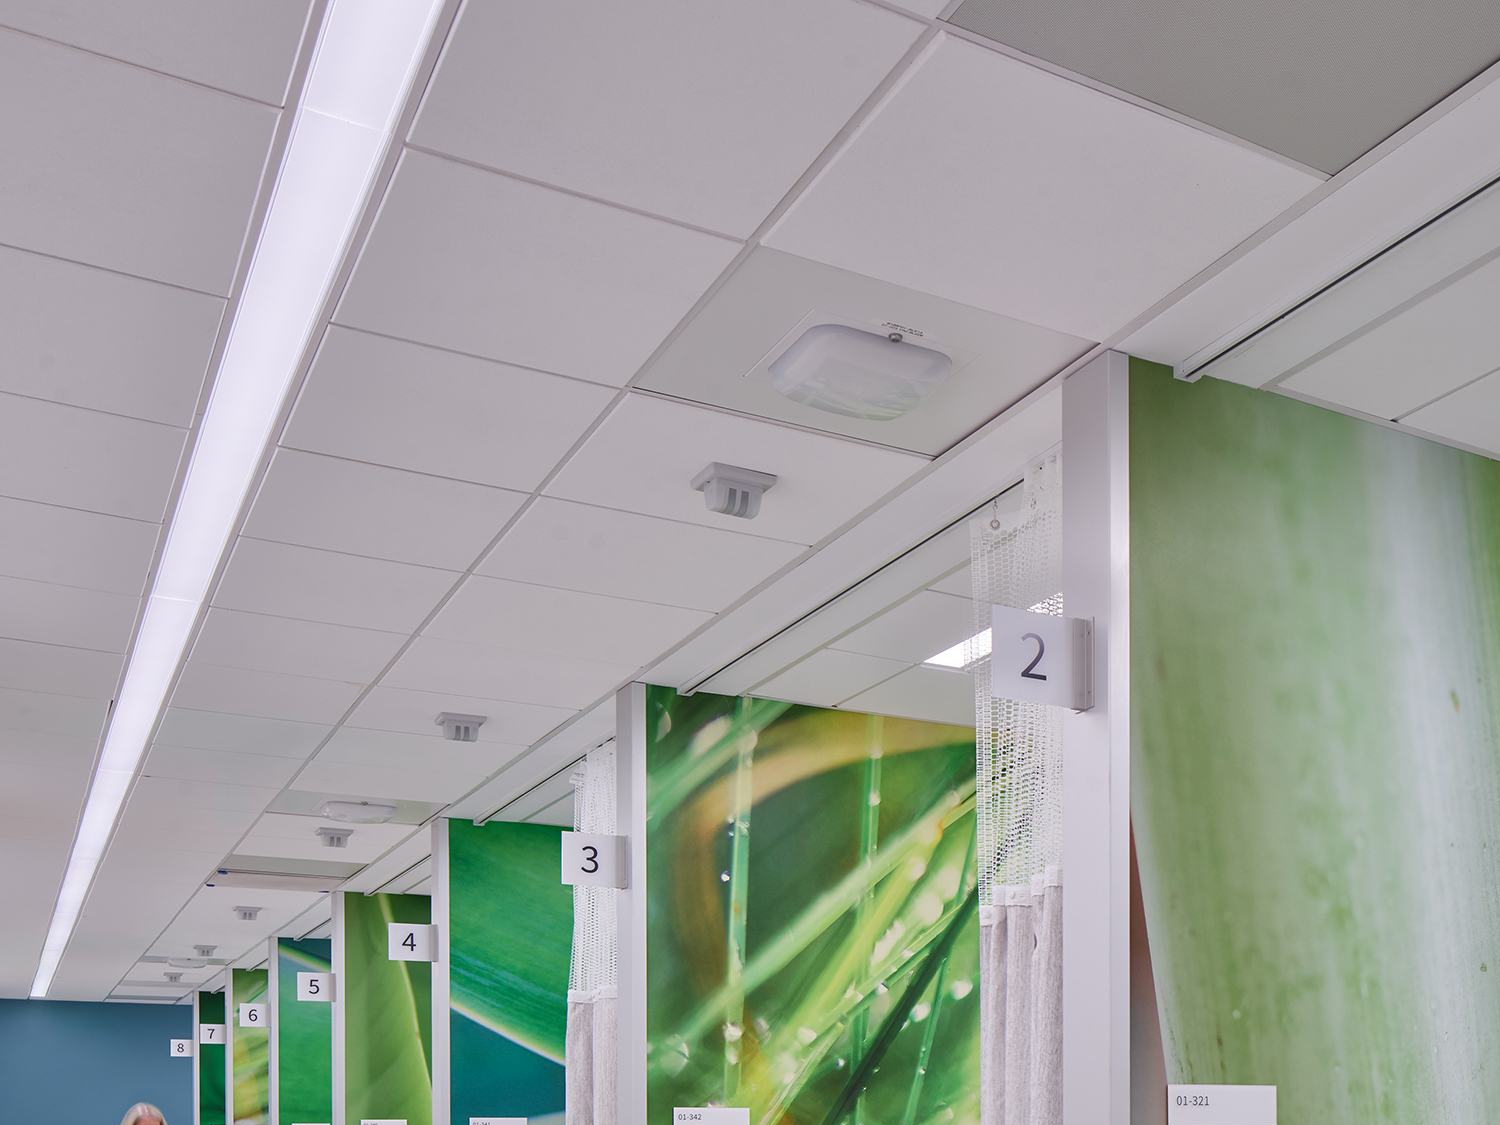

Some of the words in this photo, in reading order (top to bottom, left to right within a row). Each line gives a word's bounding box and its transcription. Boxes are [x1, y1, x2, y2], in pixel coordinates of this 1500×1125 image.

[1020, 632, 1047, 681] 2
[580, 845, 599, 874] 3
[401, 932, 417, 952] 4
[308, 979, 320, 995] 5
[248, 1008, 258, 1022] 6
[207, 1028, 215, 1040] 7
[176, 1042, 185, 1053] 8
[1176, 1095, 1210, 1106] 01-321
[677, 1113, 702, 1121] 01-342
